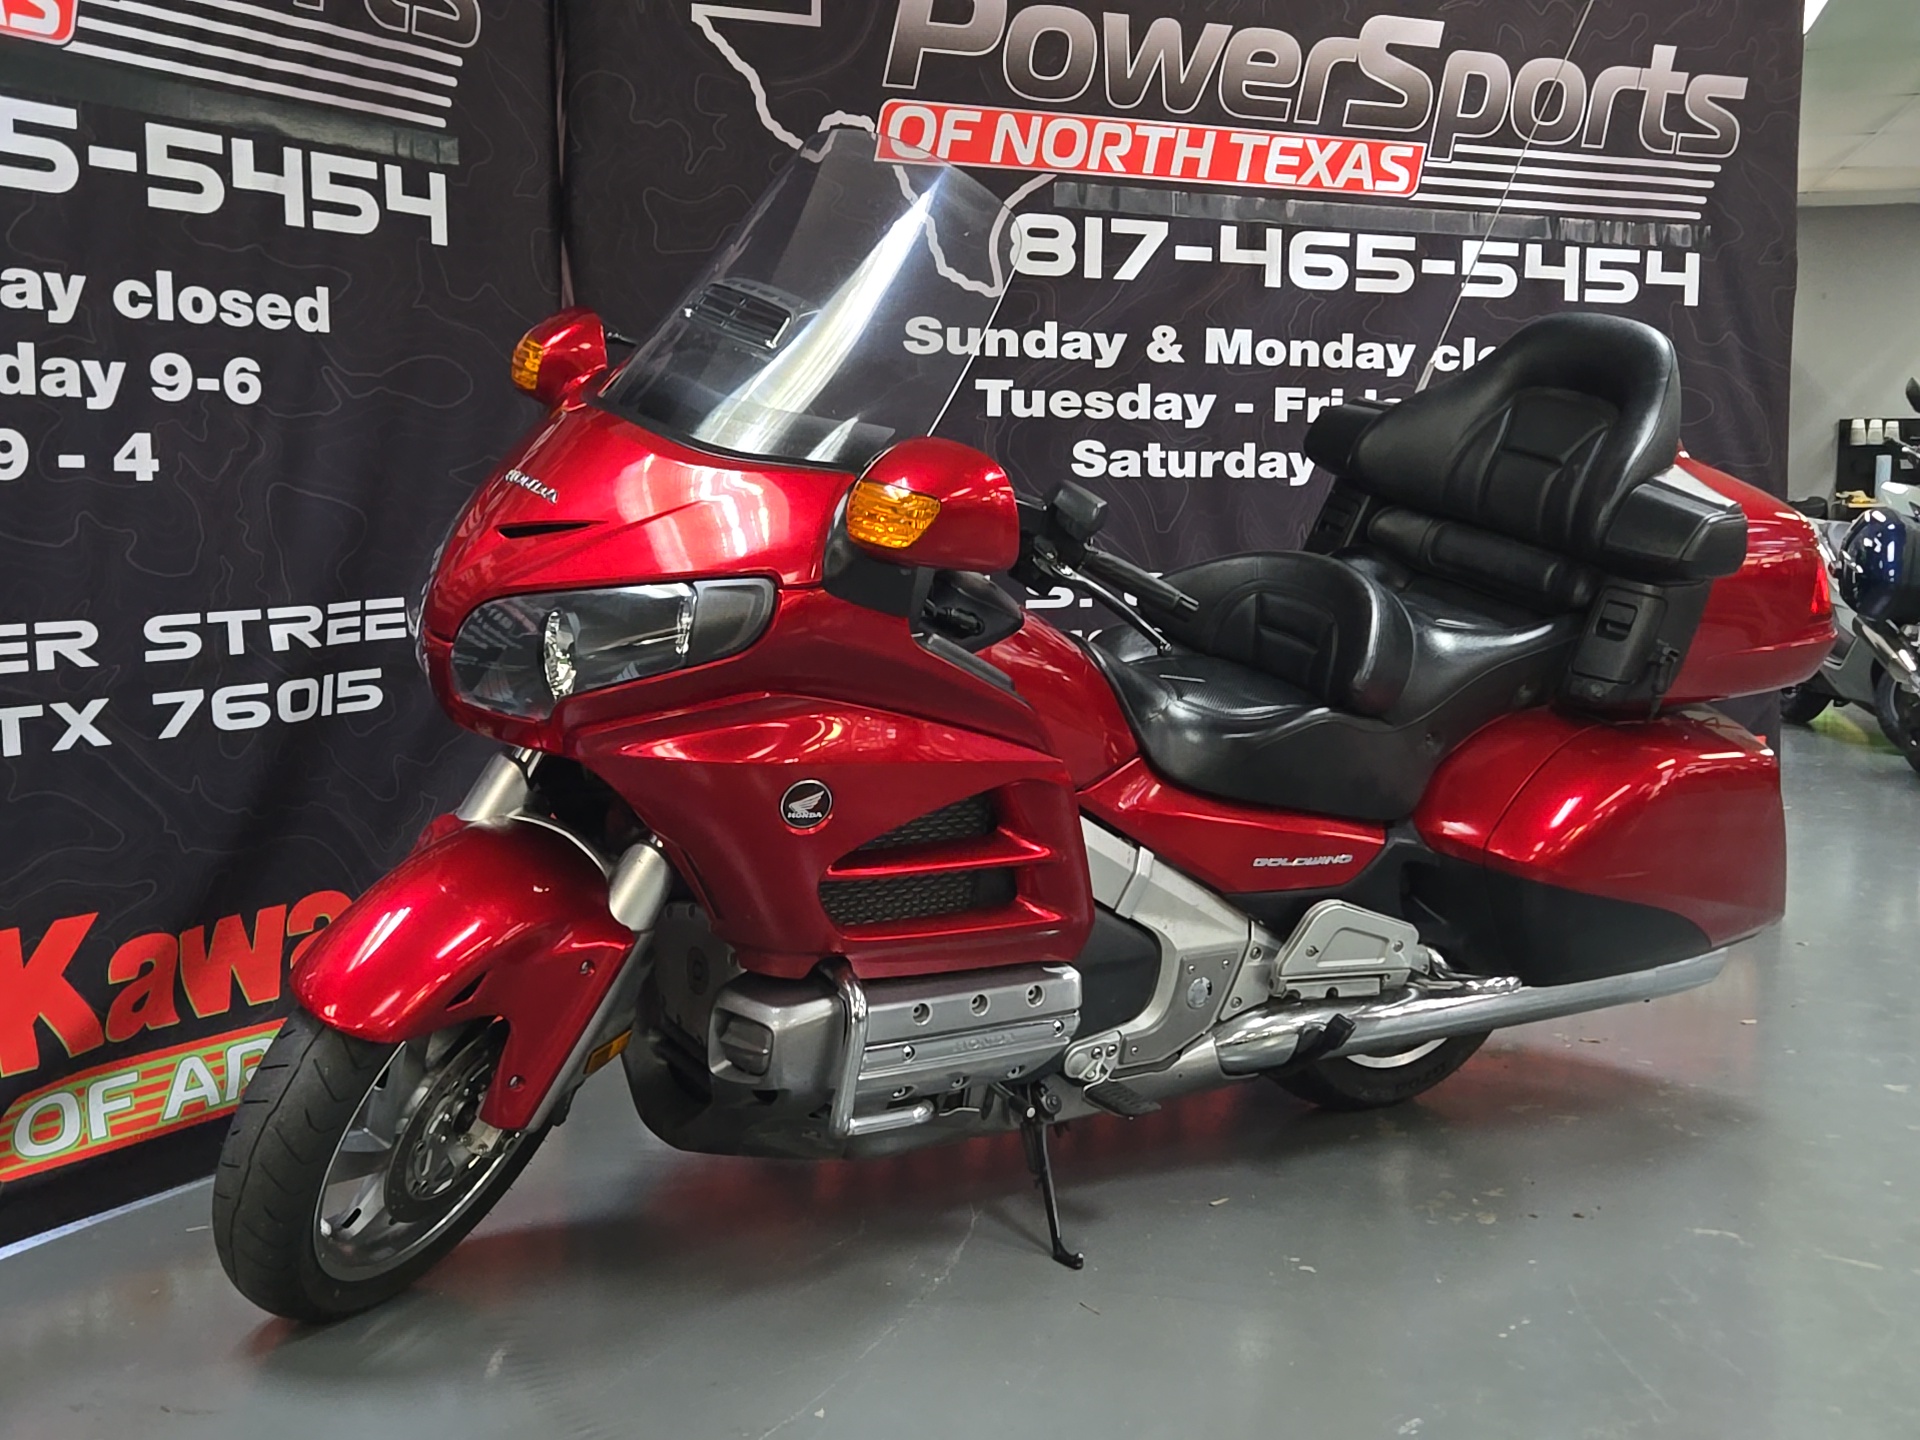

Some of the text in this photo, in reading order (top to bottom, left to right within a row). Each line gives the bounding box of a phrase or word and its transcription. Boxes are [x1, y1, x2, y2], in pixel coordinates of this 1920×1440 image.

[881, 0, 1749, 162] PowerSports
[887, 106, 1413, 193] OF NORTH TEXAS
[1009, 212, 1700, 306] 817-465-5454
[112, 270, 330, 333] closed
[903, 316, 1127, 368] Sunday
[1146, 326, 1185, 364] &
[1205, 327, 1417, 377] Monday
[150, 352, 262, 405] 9-6
[975, 378, 1216, 429] Tuesday
[1235, 403, 1254, 412] -
[58, 454, 86, 469] -
[113, 432, 160, 481] 4
[1071, 439, 1316, 487] Saturday
[0, 668, 384, 758] TX 76015
[787, 811, 823, 819] HONDA
[13, 1070, 139, 1157] OF
